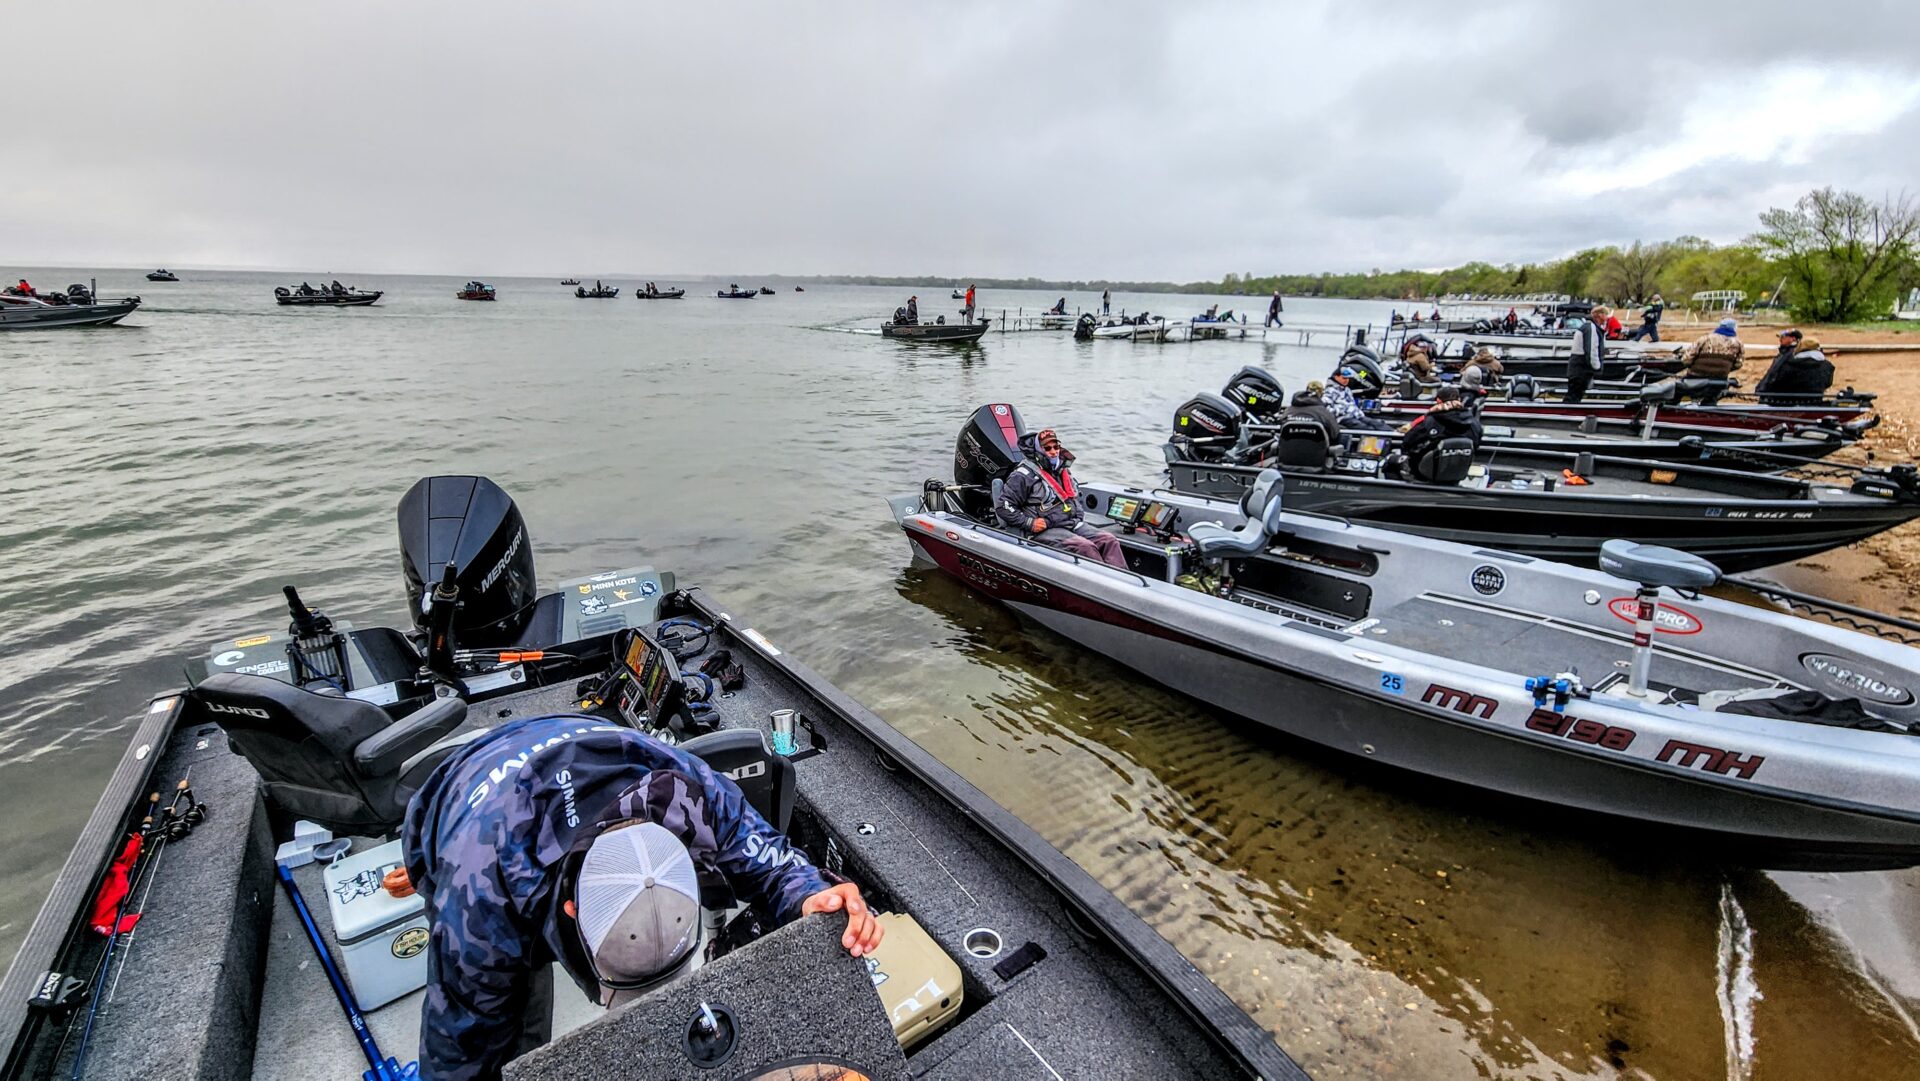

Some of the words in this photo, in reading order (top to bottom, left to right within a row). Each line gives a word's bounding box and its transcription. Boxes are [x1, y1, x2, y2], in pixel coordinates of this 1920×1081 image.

[1191, 409, 1226, 430] MERCURY
[1441, 449, 1472, 457] LUND
[480, 525, 523, 594] MERCURY
[592, 582, 615, 591] MINN
[235, 660, 289, 674] ENGEL
[1381, 675, 1402, 691] 25
[205, 701, 270, 719] LUND
[1525, 708, 1637, 752] 2198
[555, 769, 581, 828] SIMMS
